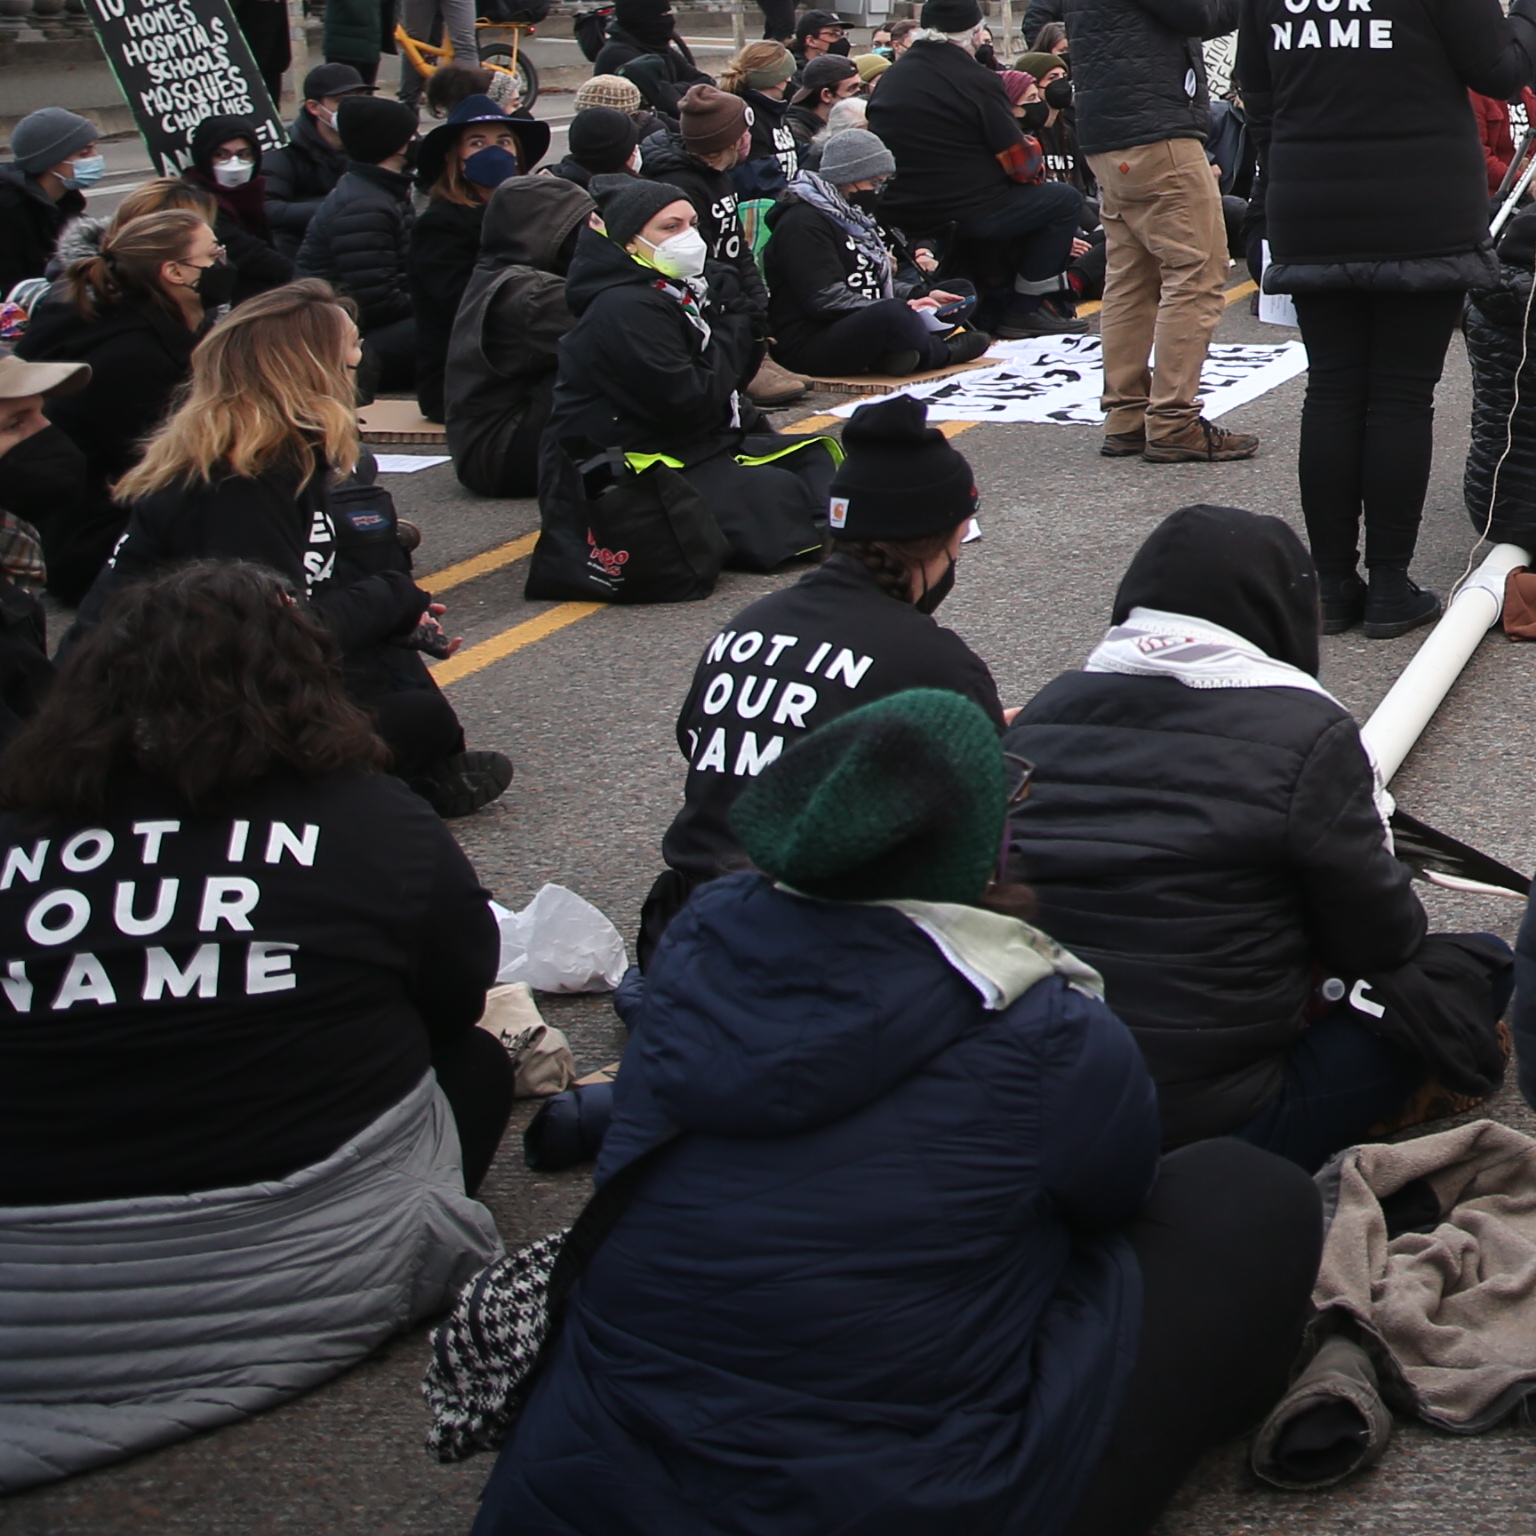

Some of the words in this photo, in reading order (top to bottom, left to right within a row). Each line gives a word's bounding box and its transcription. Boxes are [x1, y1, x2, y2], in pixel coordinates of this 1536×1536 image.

[122, 16, 229, 67] HOSPITALS
[1270, 18, 1394, 51] NAME
[140, 65, 248, 117] MOSQUES
[147, 45, 230, 85] SCHOOLS
[1042, 155, 1075, 170] EWS
[706, 630, 799, 667] NOT
[804, 641, 875, 689] IN
[702, 672, 819, 729] OUR
[0, 819, 181, 891] NOT
[226, 819, 321, 867] IN
[25, 875, 261, 947] OUR
[0, 940, 300, 1013] NAME
